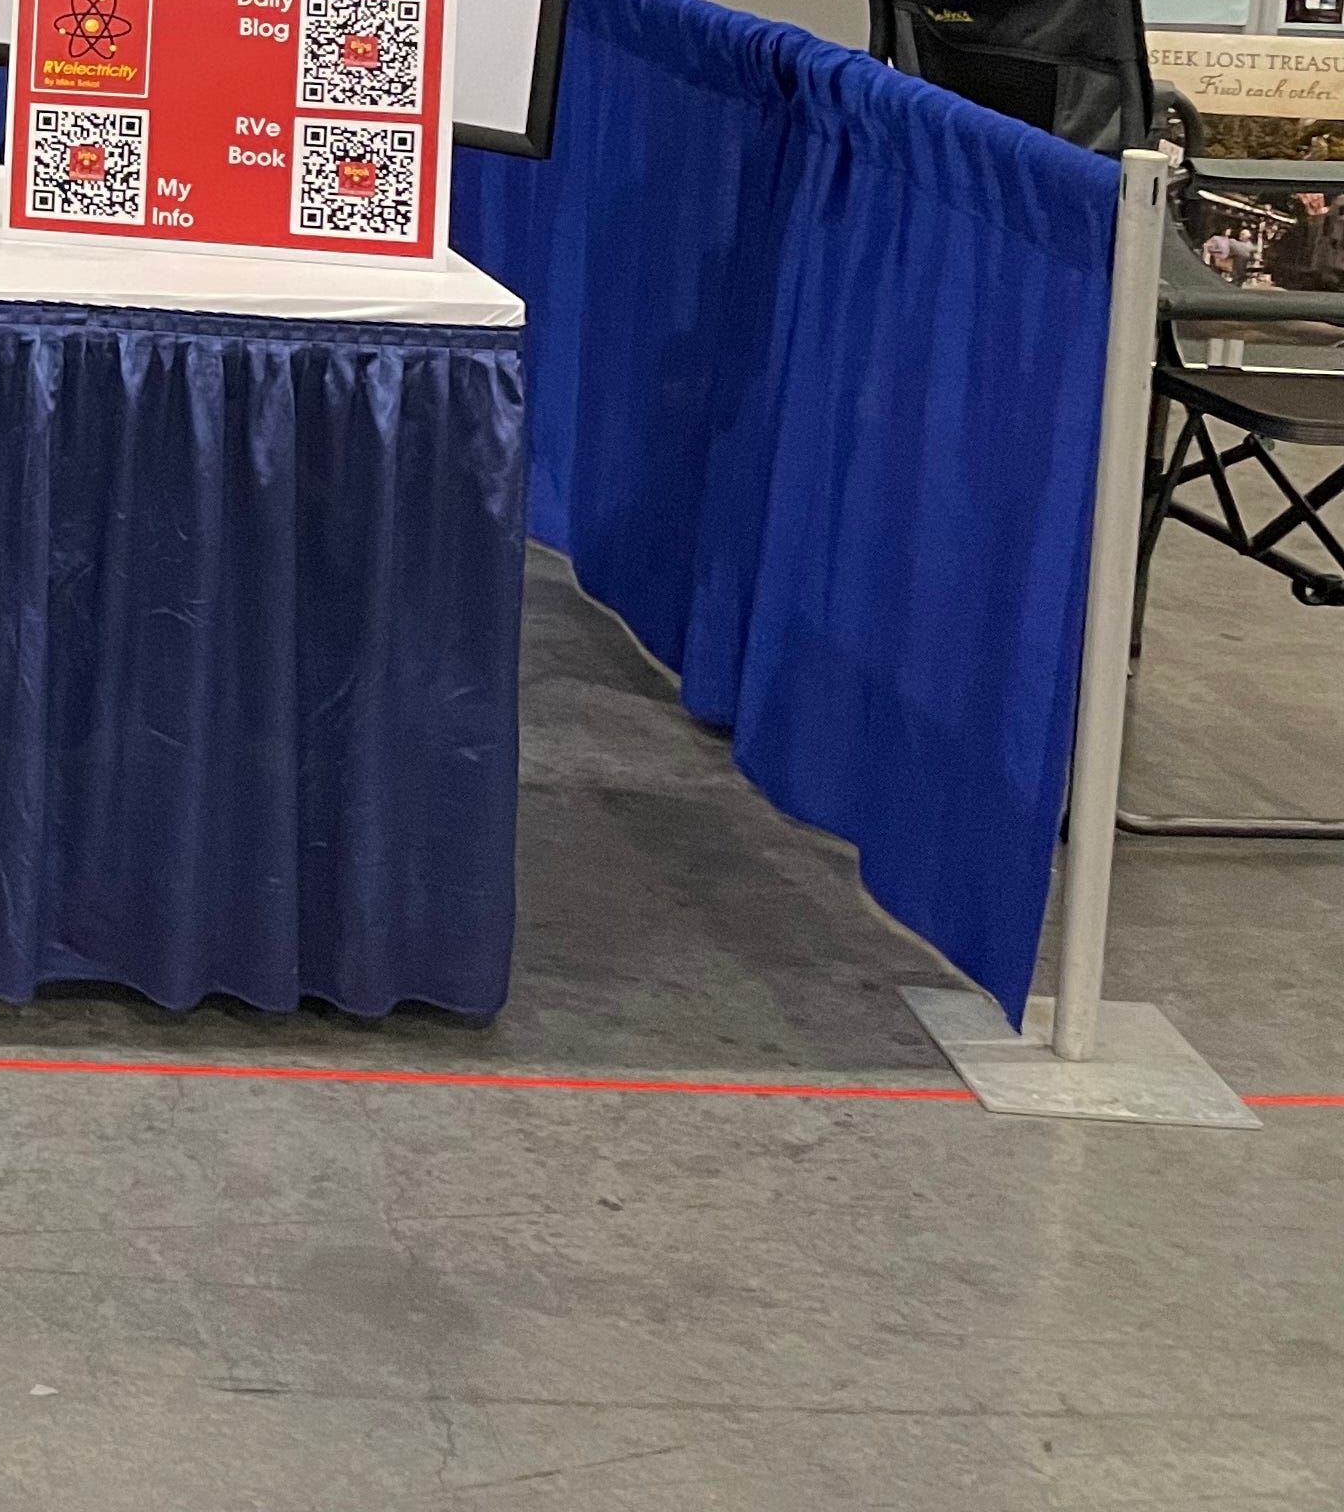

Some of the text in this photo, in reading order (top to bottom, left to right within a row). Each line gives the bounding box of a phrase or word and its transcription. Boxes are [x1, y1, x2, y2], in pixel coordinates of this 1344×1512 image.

[239, 18, 290, 42] Blog
[1150, 49, 1200, 67] SEEK
[1205, 51, 1261, 70] LOST
[43, 60, 138, 81] RVelectricity
[236, 117, 281, 138] RVe
[228, 147, 286, 168] Book
[157, 178, 192, 201] My
[152, 207, 194, 228] Info
